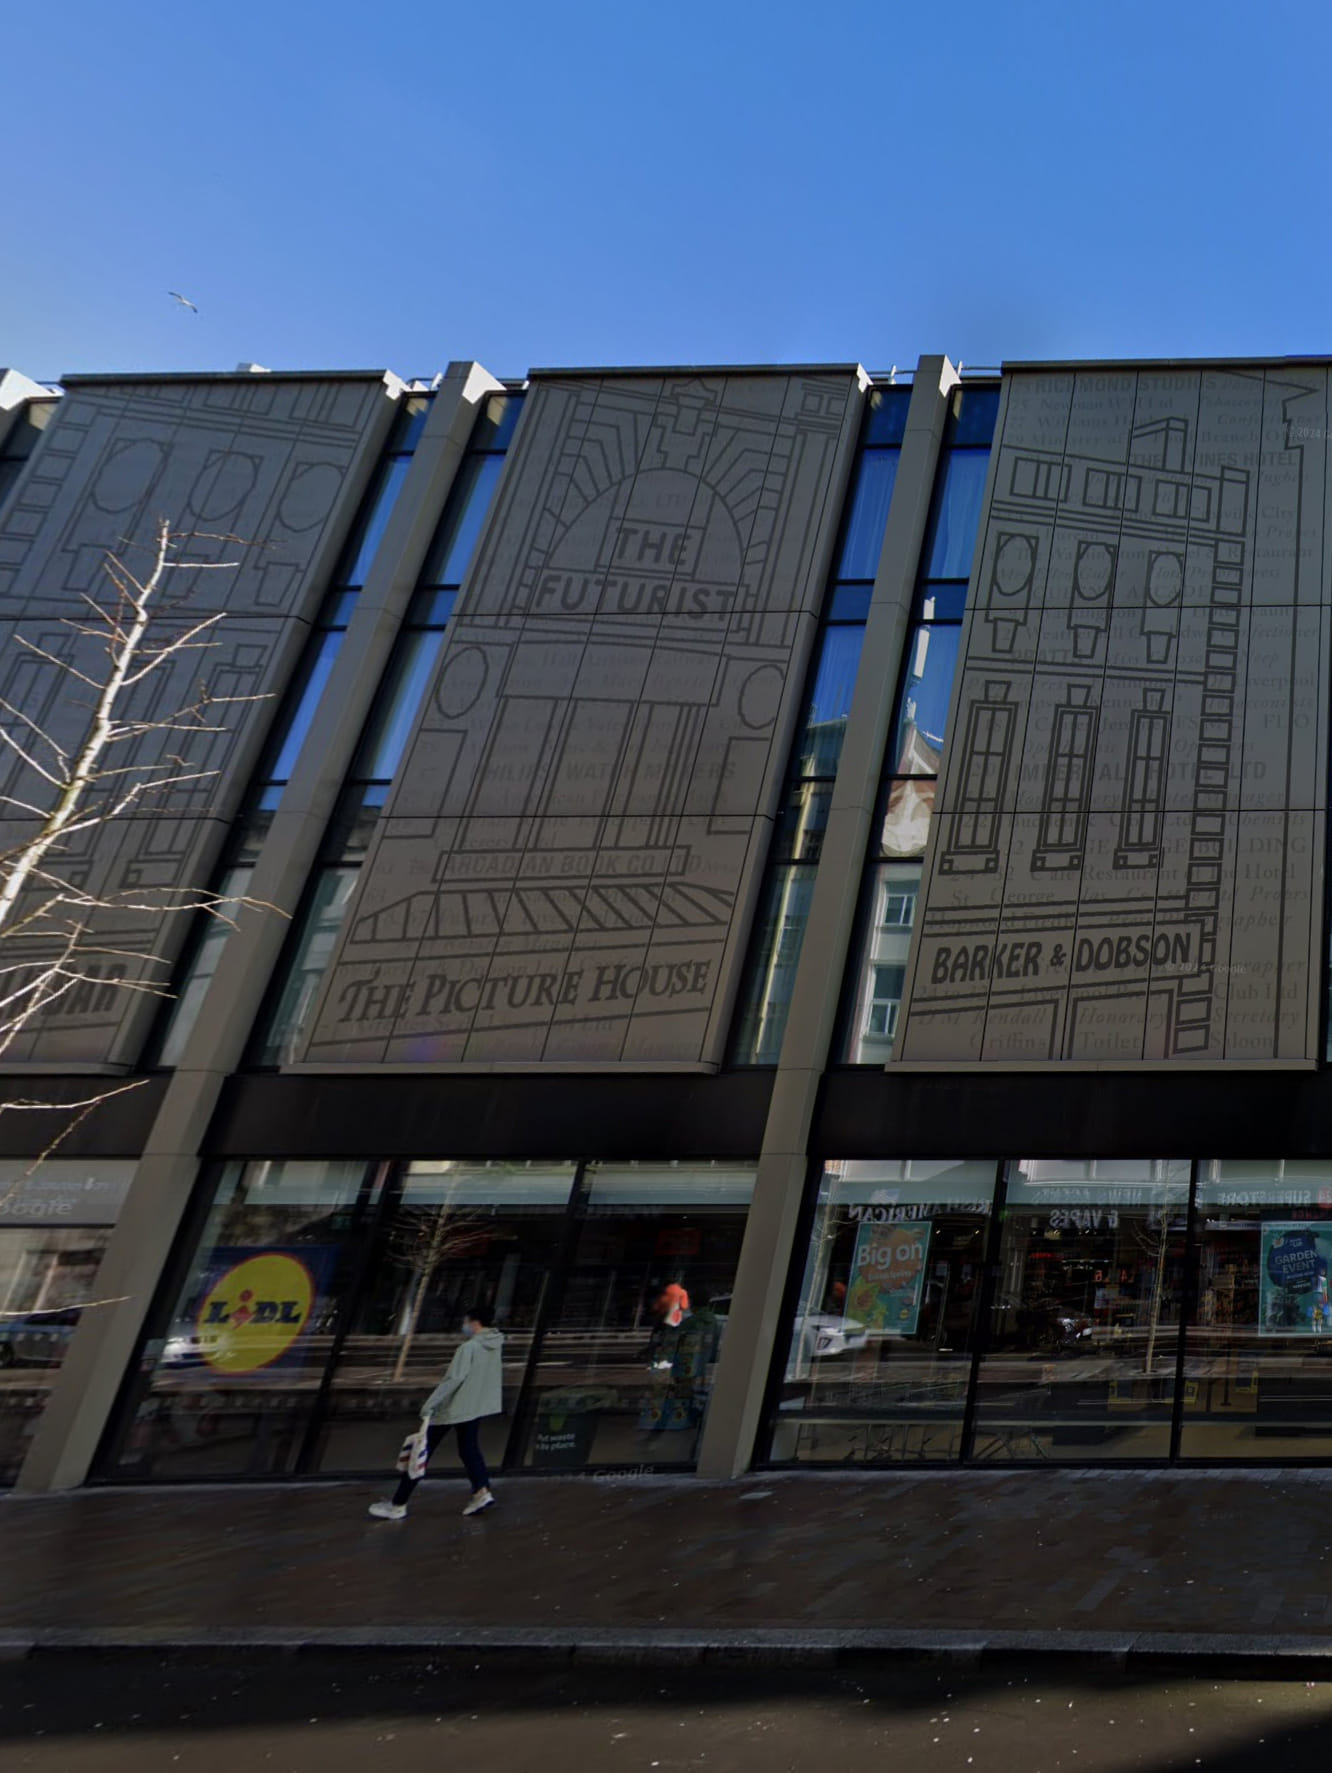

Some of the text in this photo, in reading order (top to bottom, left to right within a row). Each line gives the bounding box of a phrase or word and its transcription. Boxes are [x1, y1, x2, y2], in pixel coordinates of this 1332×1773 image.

[616, 527, 693, 566] THE
[536, 574, 737, 622] FUTURIST
[931, 932, 1191, 985] BARKER & DOBSON
[336, 958, 713, 1024] THE PICTURE HOUSE
[857, 1241, 923, 1271] Big on
[1274, 1248, 1319, 1265] GARDEN
[1281, 1258, 1317, 1274] EVENT
